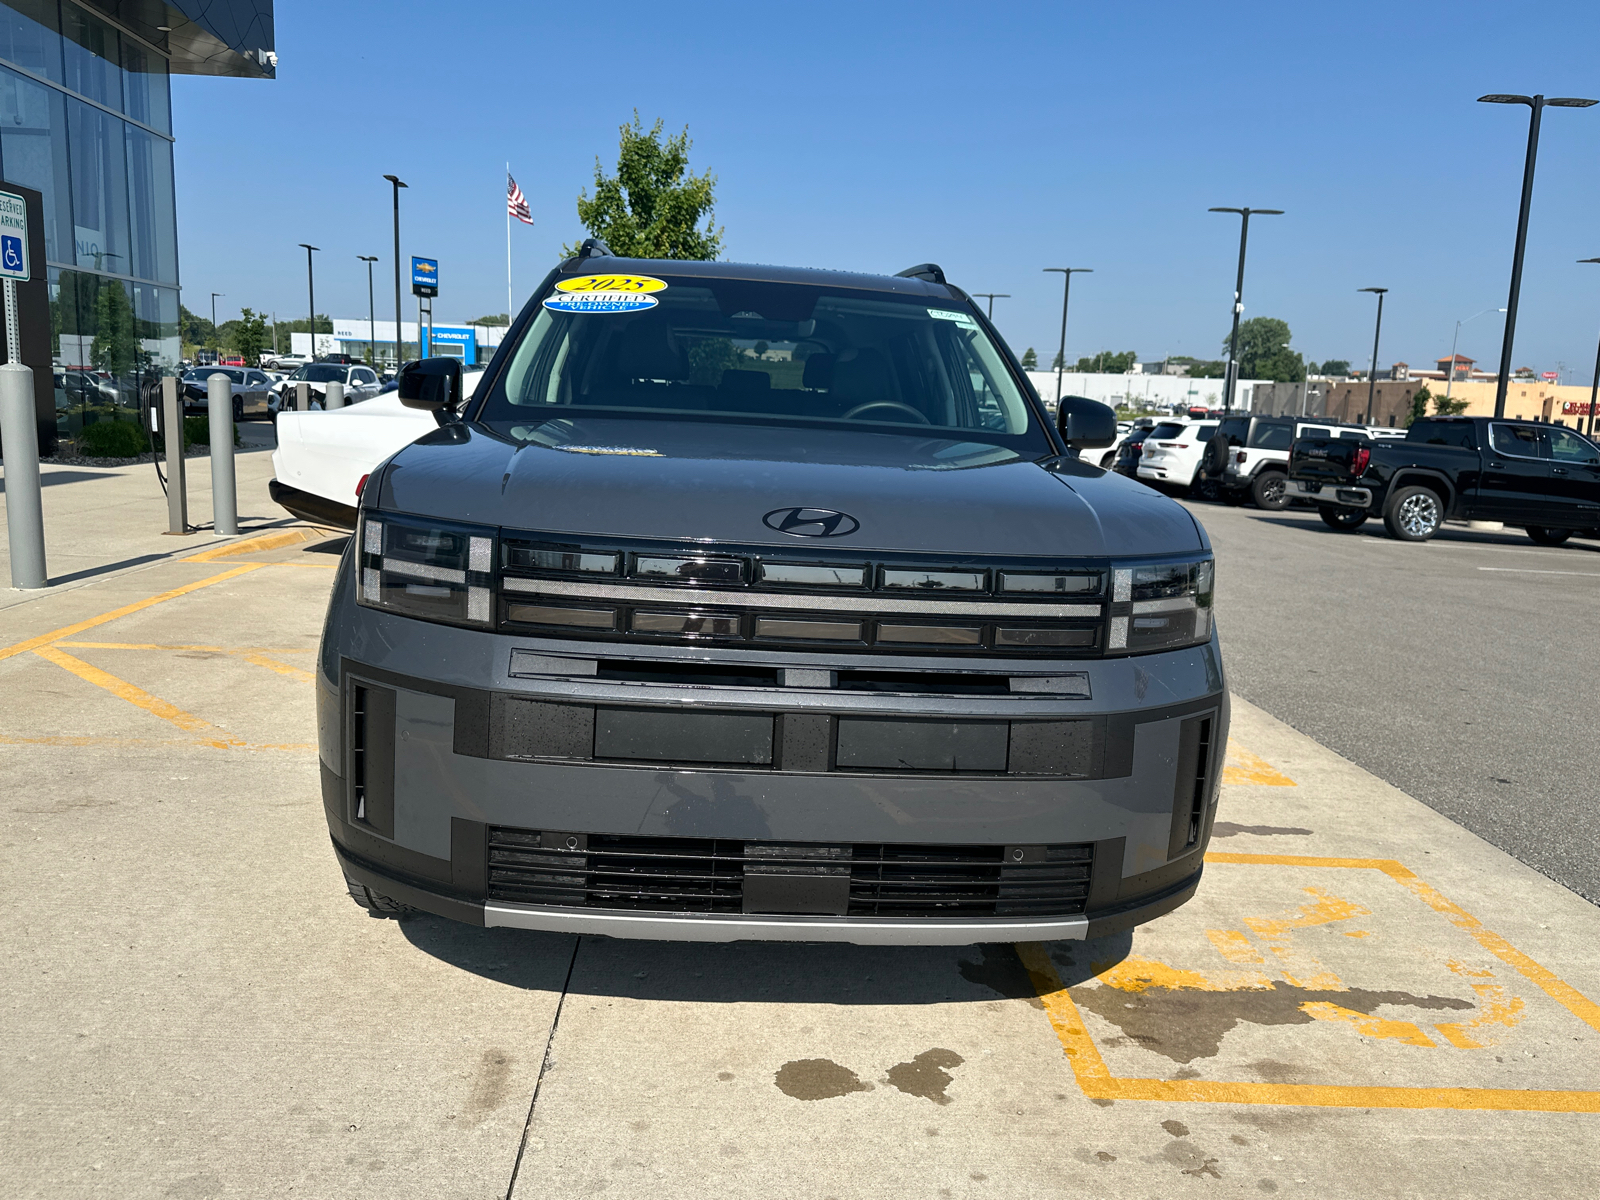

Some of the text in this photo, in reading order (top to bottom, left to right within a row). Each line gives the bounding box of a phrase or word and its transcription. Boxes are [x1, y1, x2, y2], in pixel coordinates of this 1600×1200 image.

[0, 200, 22, 216] ESERVED
[1, 215, 24, 230] ARKING
[414, 276, 437, 284] CHEVROLET
[572, 278, 651, 291] 2025
[437, 332, 470, 340] CHEVROLET
